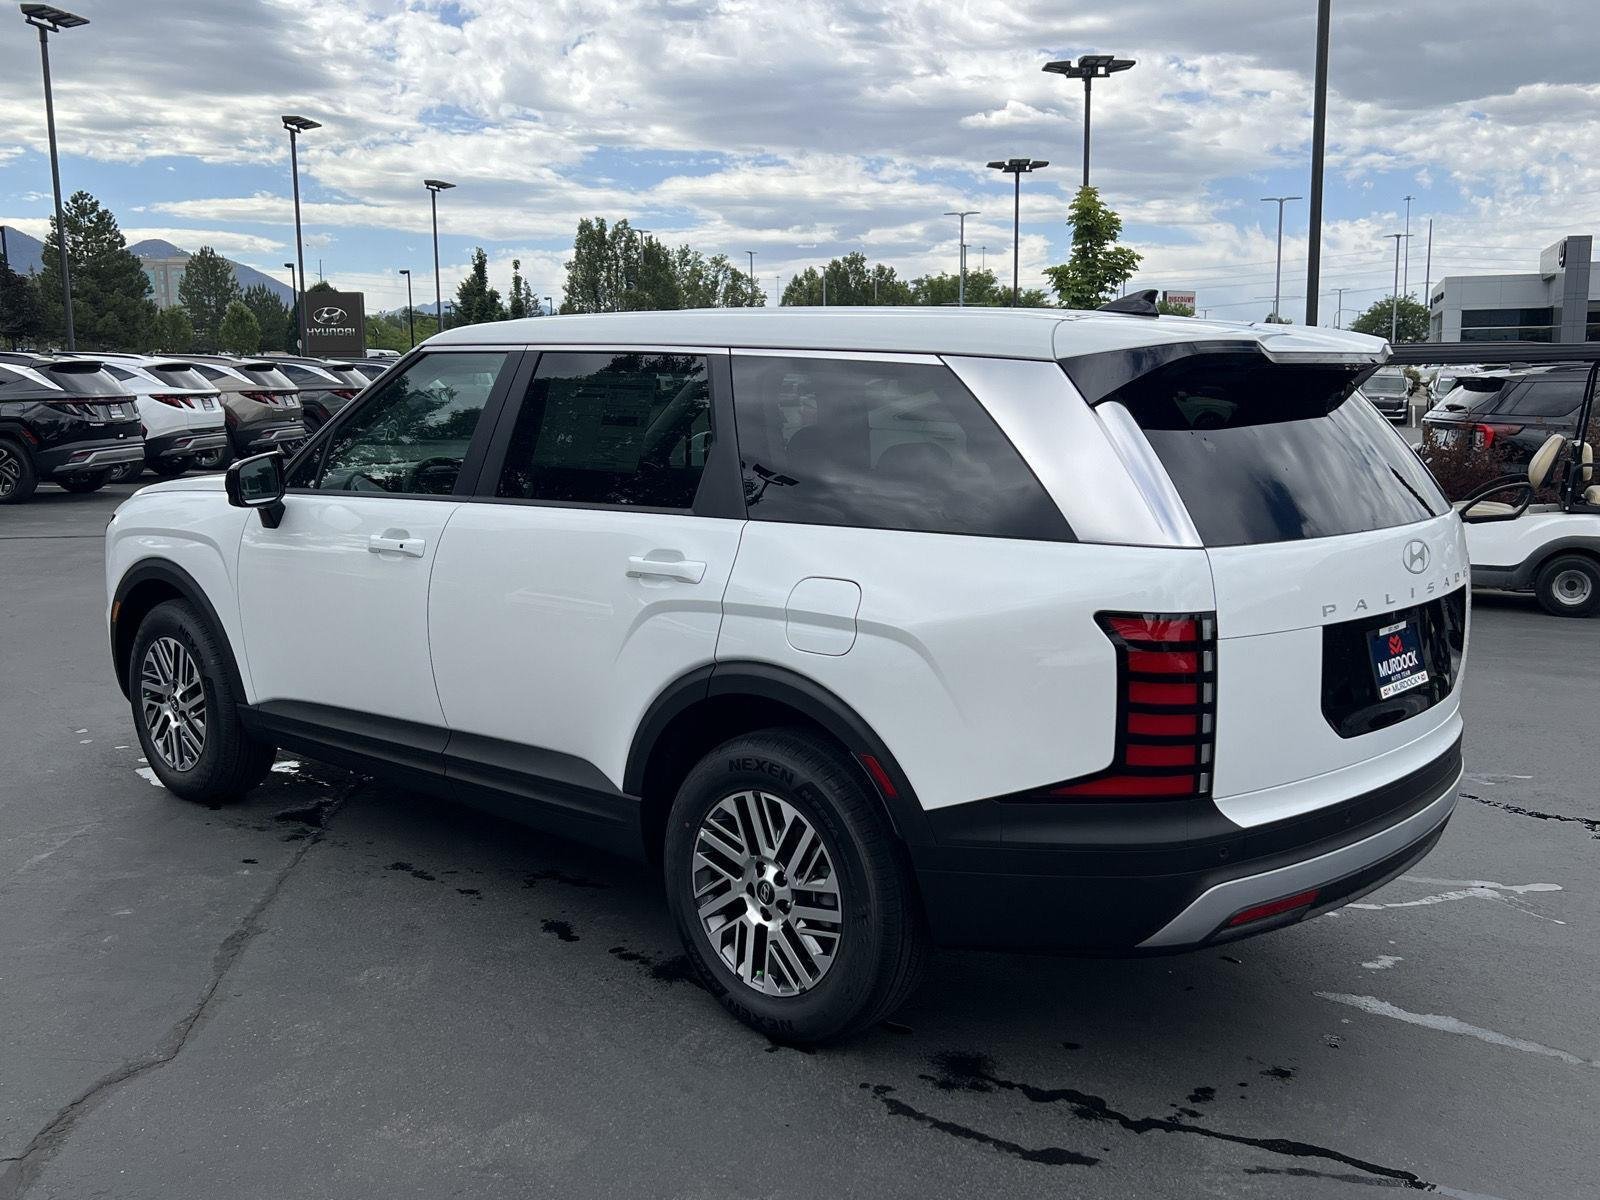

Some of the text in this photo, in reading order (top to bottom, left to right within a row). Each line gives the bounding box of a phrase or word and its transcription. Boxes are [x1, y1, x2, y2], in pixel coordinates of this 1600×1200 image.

[306, 327, 356, 336] HYUNDAI
[1322, 566, 1468, 617] PALISADE
[1377, 650, 1419, 678] MURDOCK
[728, 758, 793, 785] NEXEN
